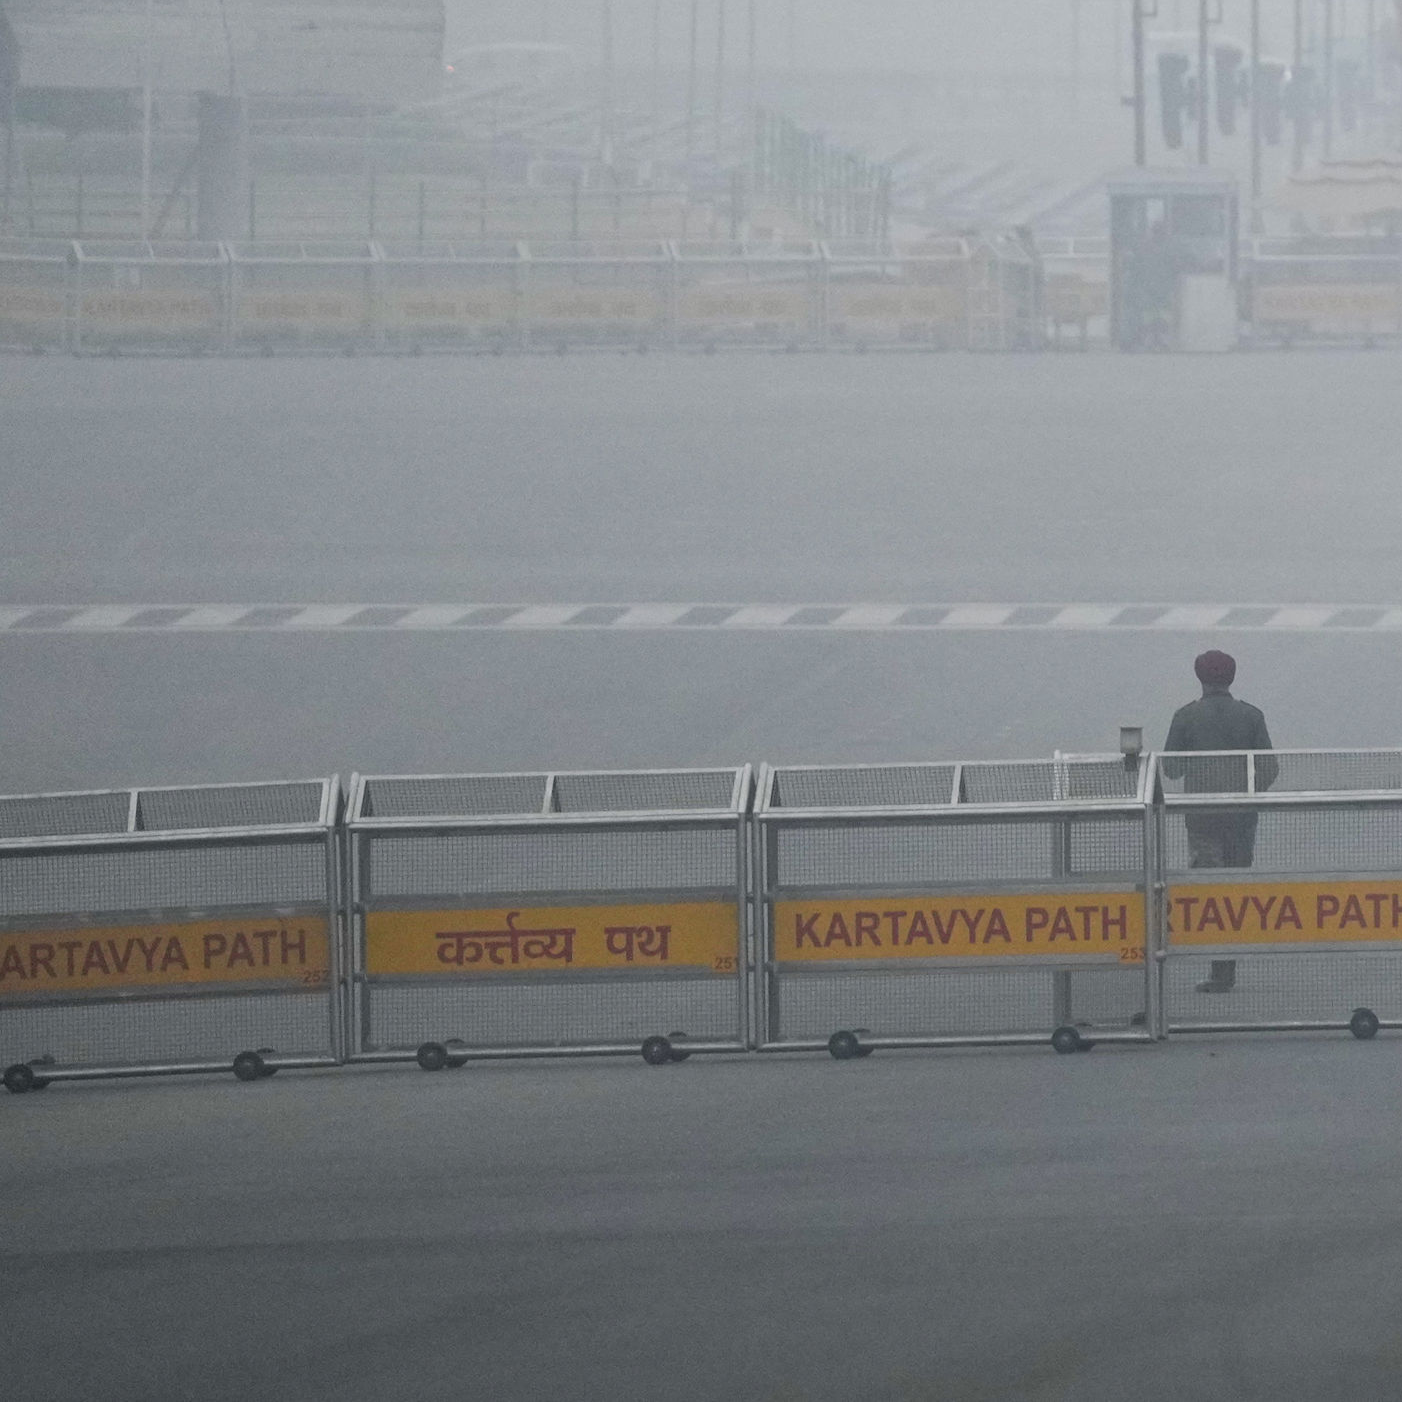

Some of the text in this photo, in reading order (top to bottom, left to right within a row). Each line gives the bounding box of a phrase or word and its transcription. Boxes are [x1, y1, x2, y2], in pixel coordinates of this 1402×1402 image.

[604, 925, 671, 962] पथ
[794, 905, 1128, 949] KARTAVYA PATH
[0, 929, 306, 980] ARTAVYA PATH
